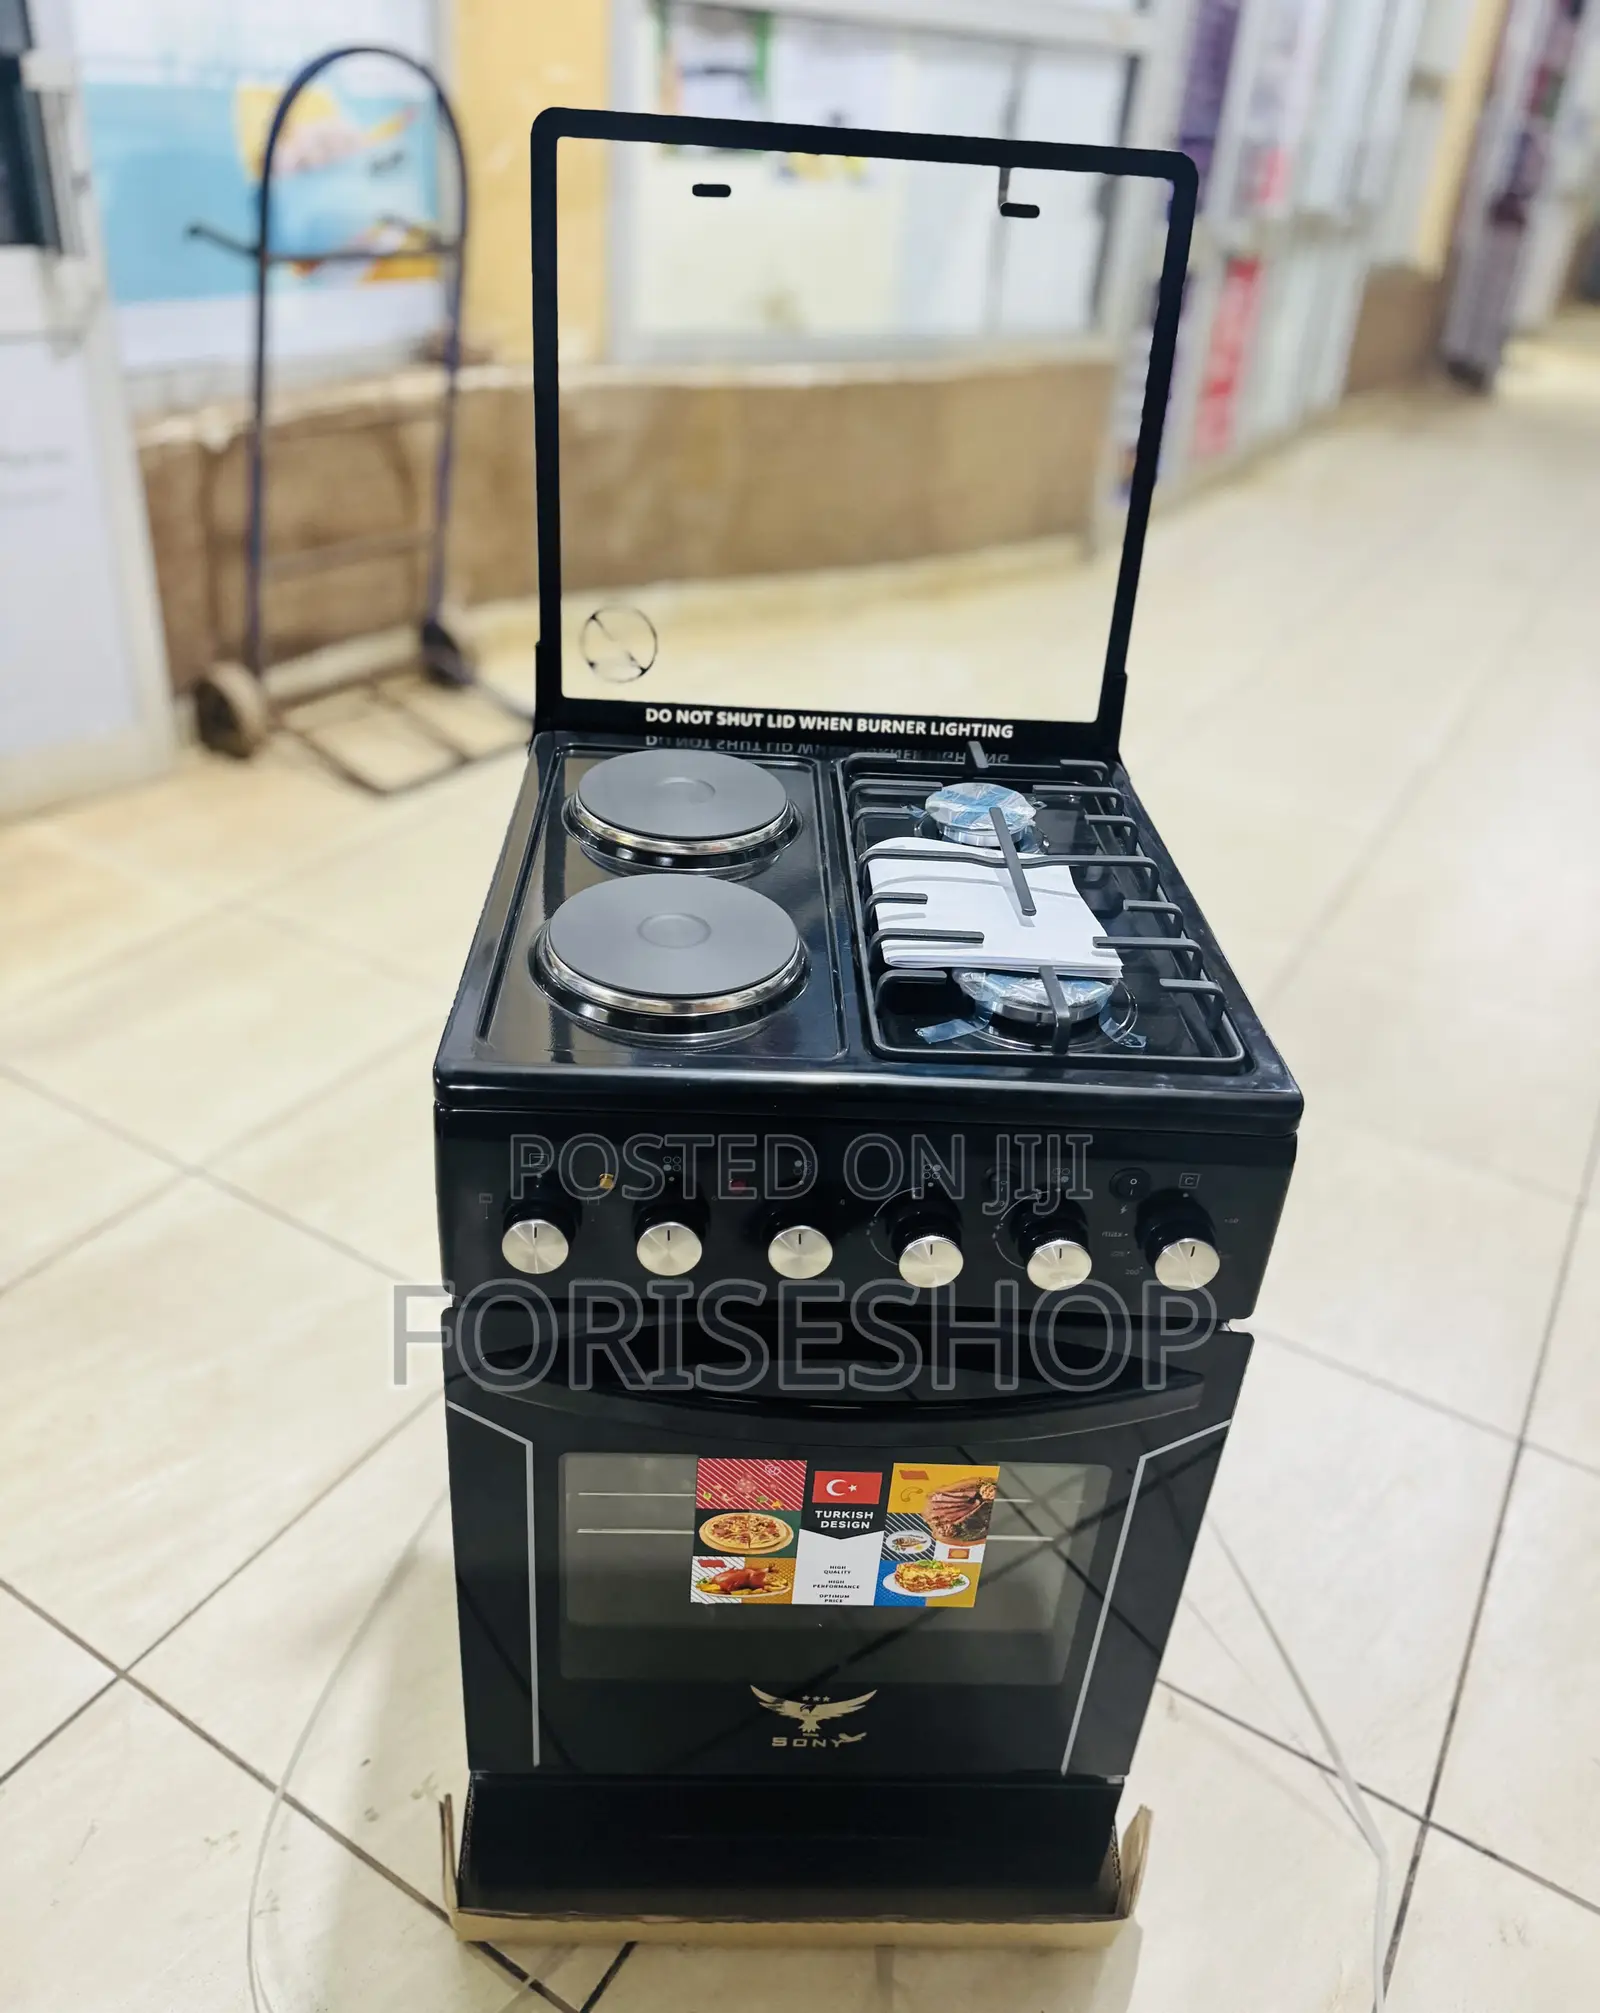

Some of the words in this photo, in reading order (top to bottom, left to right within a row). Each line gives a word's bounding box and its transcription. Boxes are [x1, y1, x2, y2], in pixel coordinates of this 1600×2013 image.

[645, 707, 673, 723] DO
[676, 709, 713, 725] NOT
[716, 711, 764, 728] SHUT
[766, 714, 796, 729] LID
[798, 715, 853, 732] WHEN
[856, 718, 927, 735] BURNER
[930, 721, 1014, 739] LIGHTING
[815, 1509, 874, 1520] TURKISH
[820, 1520, 871, 1530] DESIGN
[772, 1734, 856, 1748] SONY
